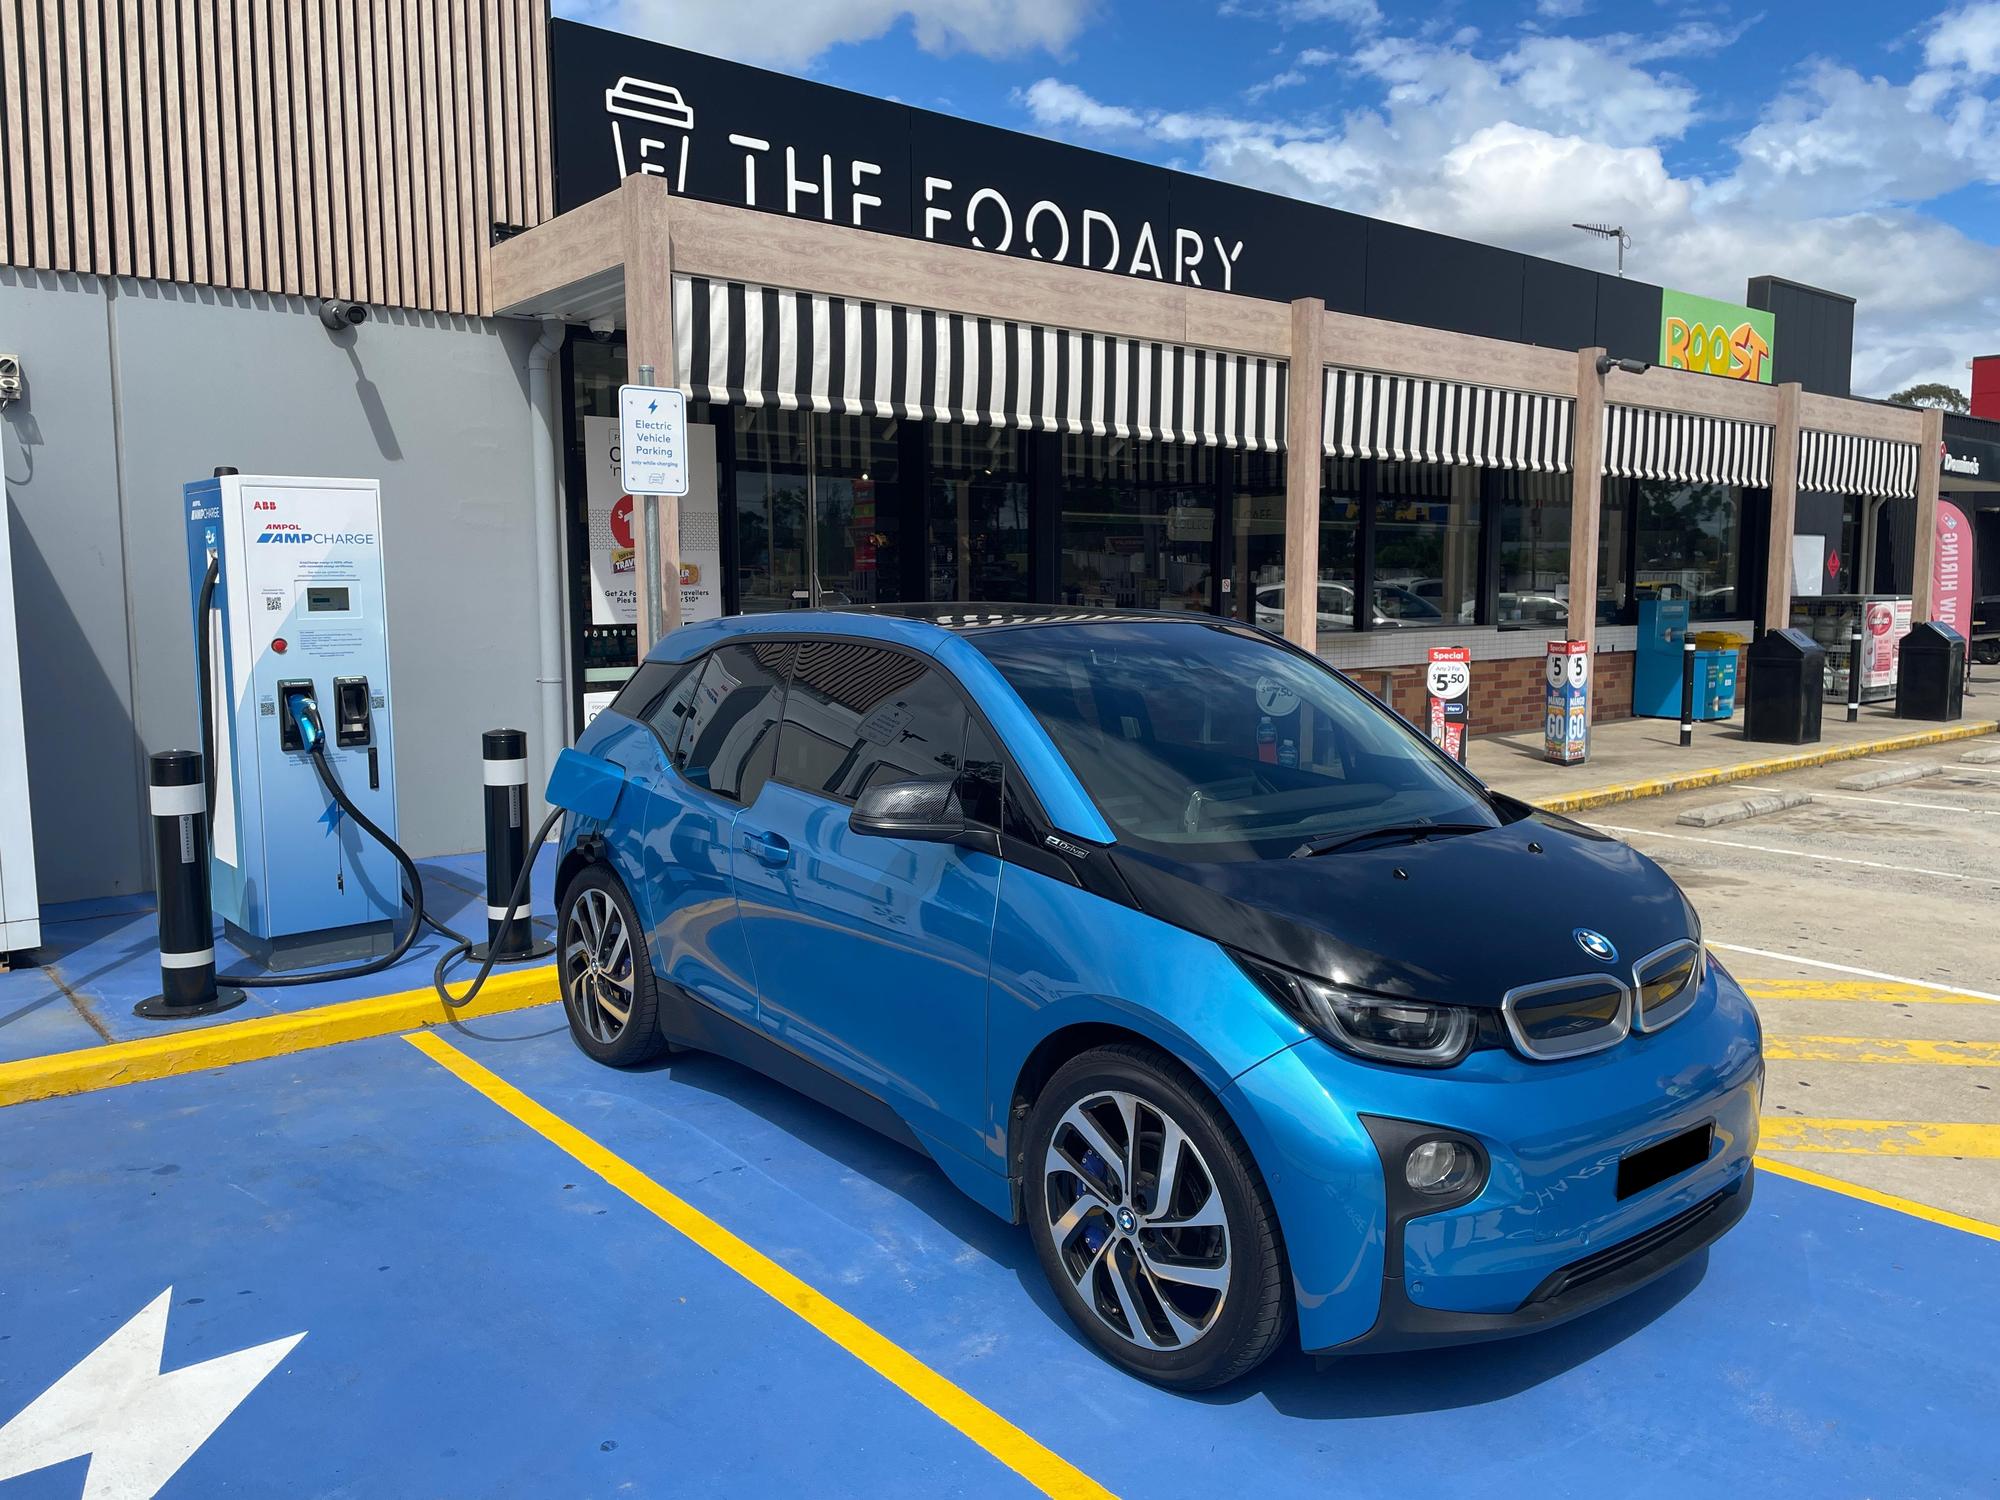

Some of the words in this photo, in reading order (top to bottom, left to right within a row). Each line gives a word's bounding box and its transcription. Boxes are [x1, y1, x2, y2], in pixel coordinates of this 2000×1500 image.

[728, 133, 883, 226] THE
[924, 176, 1243, 292] FOODARY
[1664, 316, 1769, 381] BOOST
[635, 419, 672, 430] Electric
[637, 433, 671, 443] Vehicle
[636, 445, 673, 458] Parking
[253, 501, 277, 511] ABB
[265, 523, 302, 531] AMPOL
[271, 532, 375, 545] AMPCHARGE
[1571, 644, 1586, 653] Special
[1433, 651, 1464, 661] Special
[1432, 673, 1465, 692] $5.50
[1546, 713, 1565, 739] GO
[1569, 713, 1585, 740] GO
